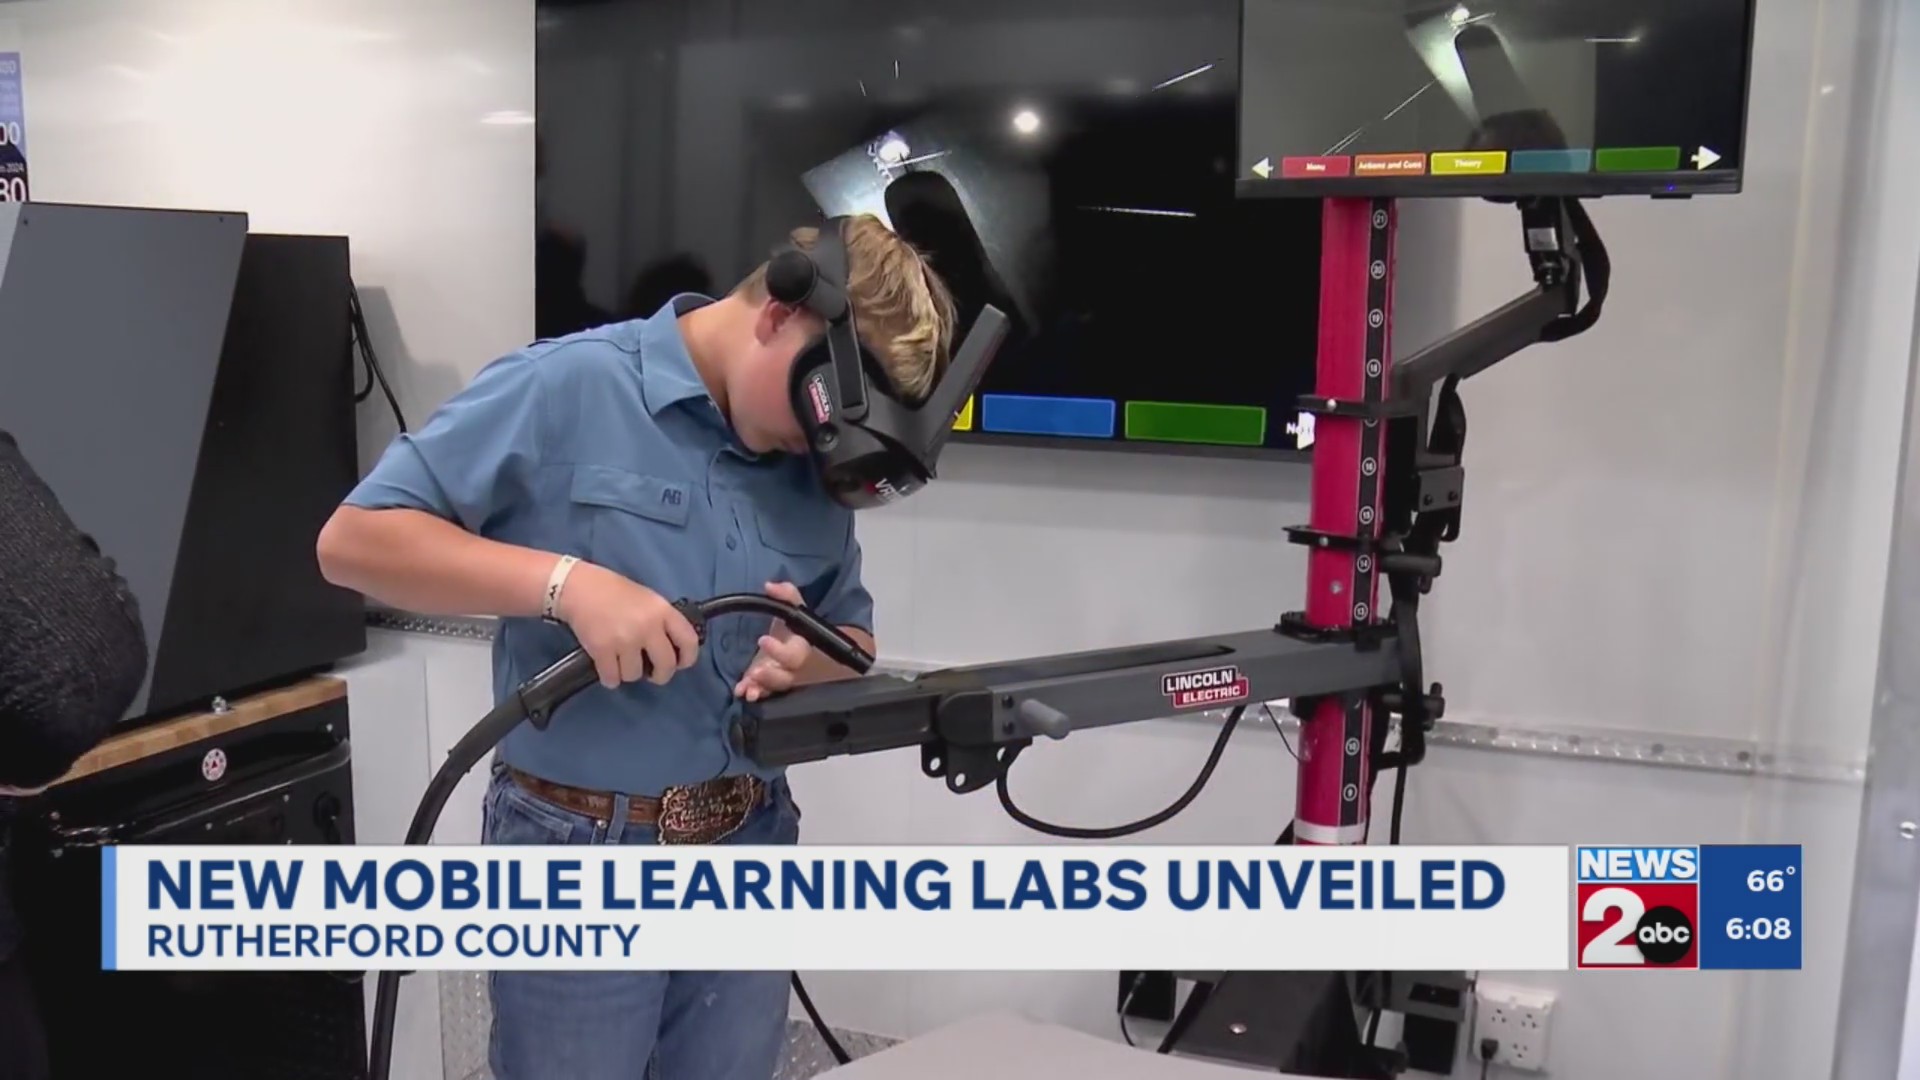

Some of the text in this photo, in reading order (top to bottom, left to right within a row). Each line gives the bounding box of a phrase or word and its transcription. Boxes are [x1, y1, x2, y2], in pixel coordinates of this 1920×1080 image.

[1387, 161, 1401, 170] and
[1454, 159, 1482, 169] Theory
[1166, 669, 1233, 692] LINCOLN
[1182, 685, 1241, 704] ELECTRIC
